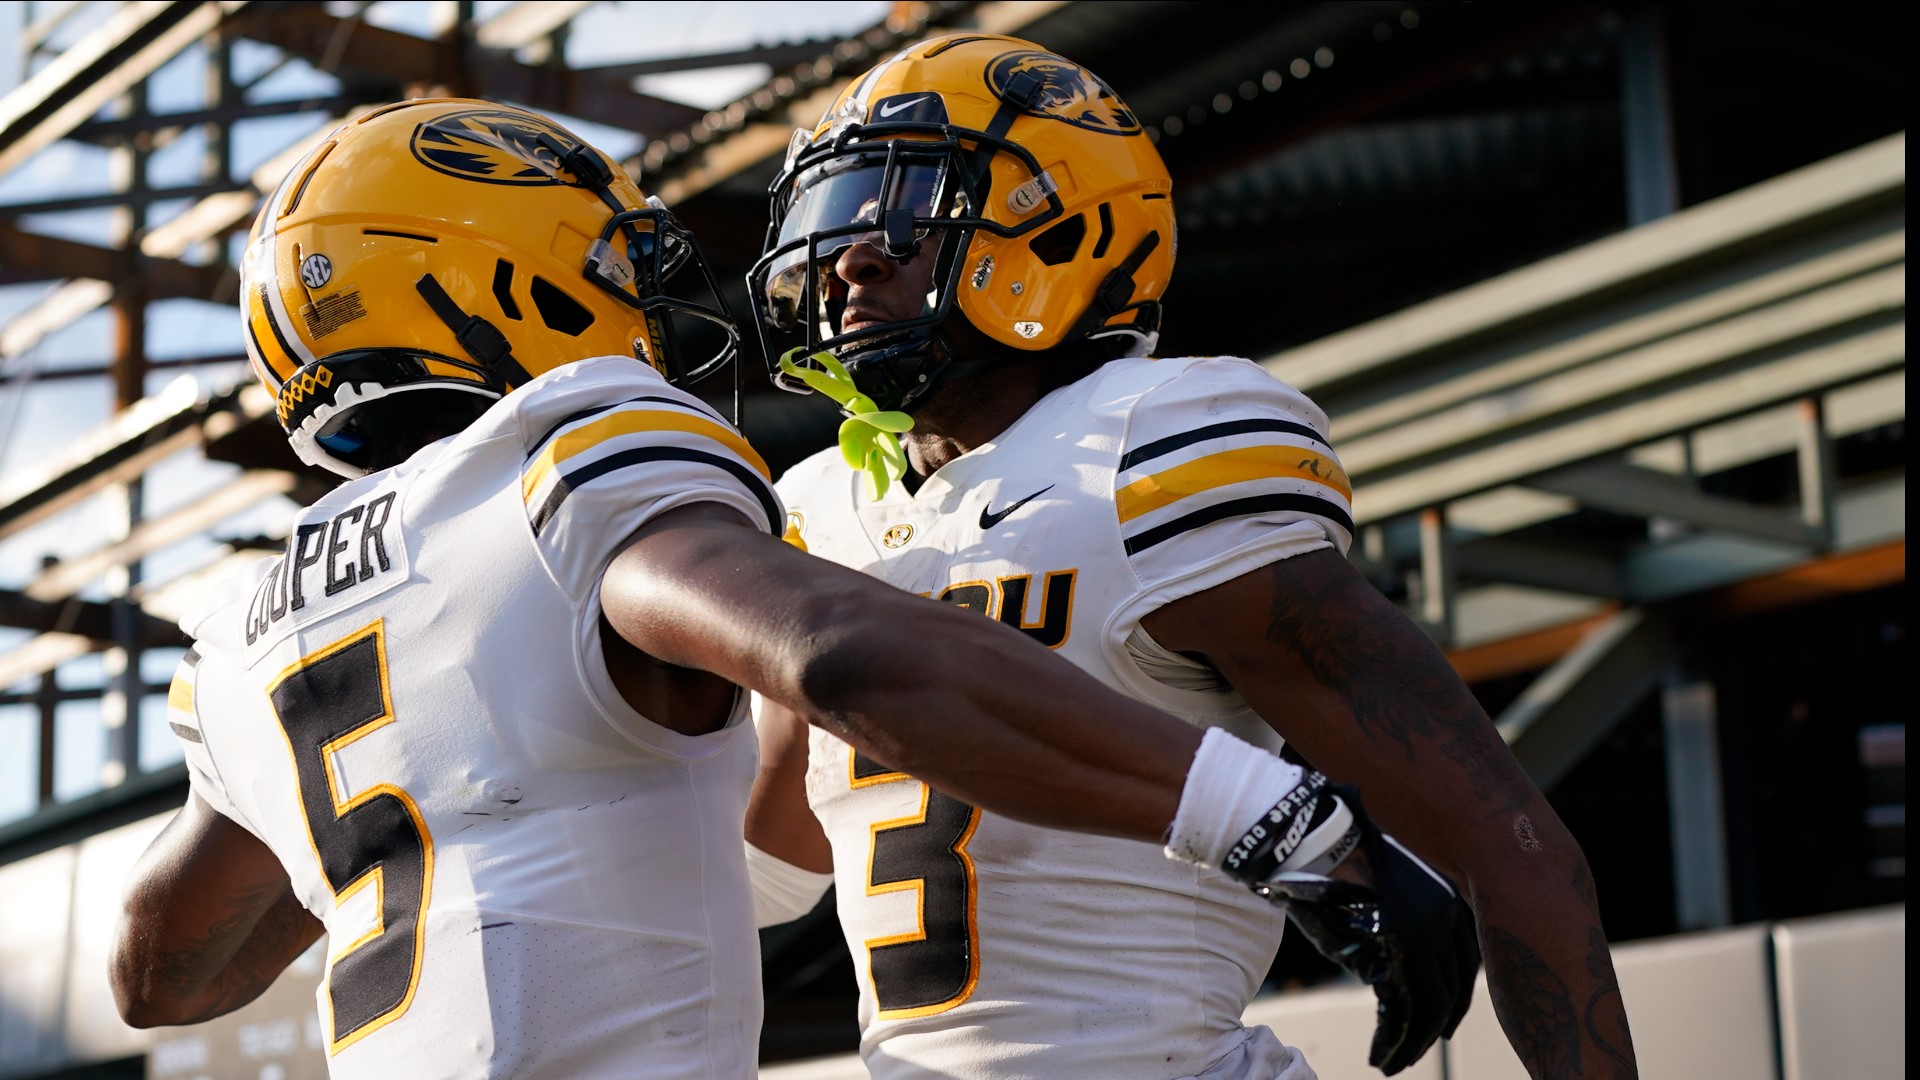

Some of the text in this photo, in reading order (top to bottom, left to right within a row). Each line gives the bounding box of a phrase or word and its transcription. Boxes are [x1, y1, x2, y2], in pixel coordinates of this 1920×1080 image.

[301, 254, 332, 288] SEC
[245, 490, 397, 646] COOPER
[265, 616, 436, 1058] 5
[848, 744, 983, 1021] 3
[1226, 824, 1267, 870] outs
[1272, 796, 1319, 864] IZZOU
